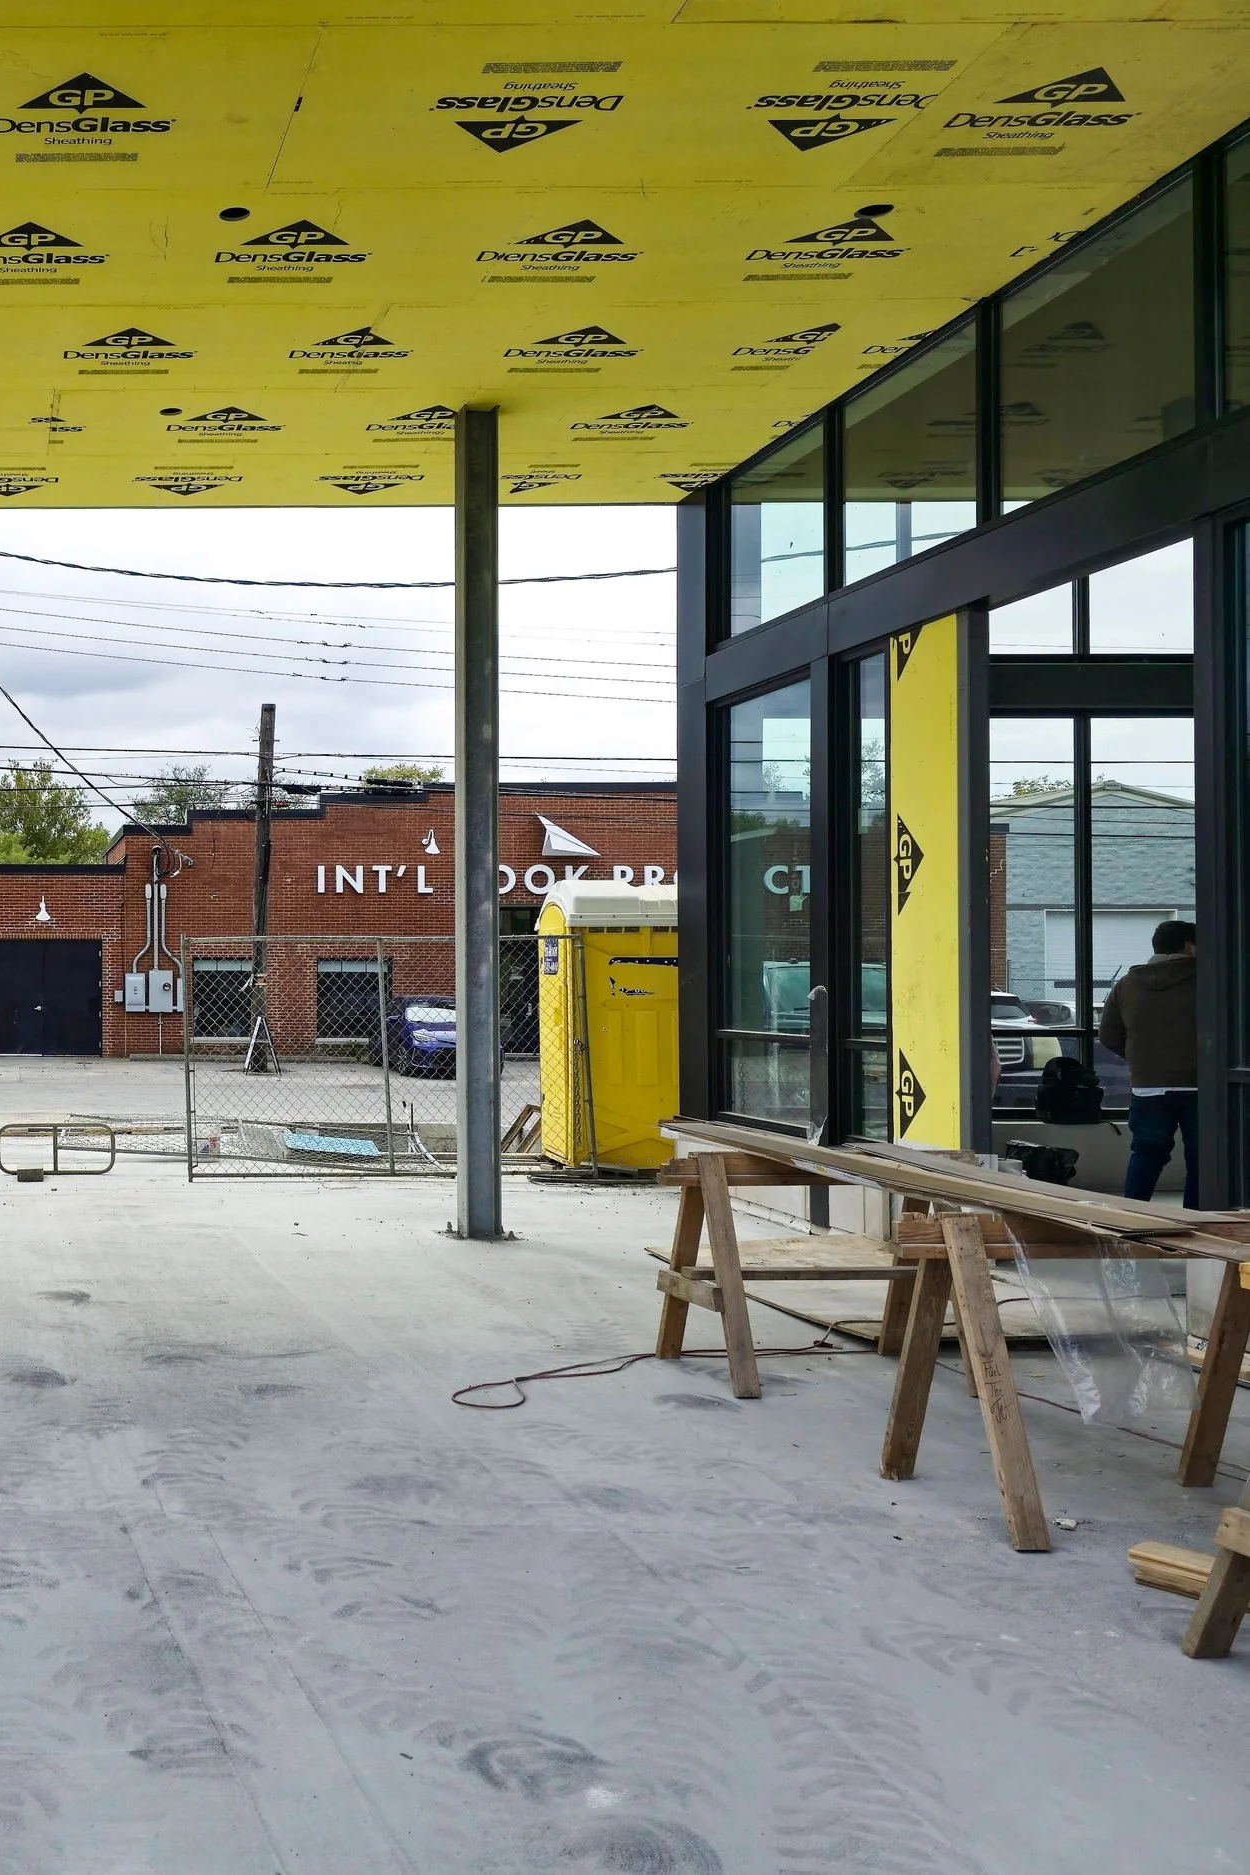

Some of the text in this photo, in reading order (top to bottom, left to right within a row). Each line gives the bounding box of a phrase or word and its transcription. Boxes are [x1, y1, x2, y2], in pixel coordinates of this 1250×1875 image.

[503, 81, 578, 91] Sheathing
[829, 80, 906, 89] Sheathing
[49, 89, 114, 106] GP
[1034, 83, 1108, 101] GP
[433, 95, 624, 112] DensGlass
[943, 111, 1133, 128] DensGlass
[481, 122, 548, 139] GP
[790, 120, 860, 138] GP
[44, 137, 112, 147] Sheathing
[982, 131, 1054, 141] Sheathing
[0, 234, 56, 245] GP
[268, 231, 324, 244] GP
[543, 230, 602, 244] GP
[815, 228, 876, 242] GP
[214, 250, 368, 263] DensGlass
[745, 248, 904, 261] DensGlass
[255, 264, 314, 272] Sheathing
[520, 264, 581, 272] Sheathing
[780, 262, 841, 270] Sheathing
[105, 336, 153, 346] GP
[558, 334, 608, 344] GP
[63, 350, 194, 360] DensGlass
[503, 348, 639, 358] DensGlass
[166, 424, 283, 432] DensGlass
[570, 422, 690, 430] DensGlass
[897, 833, 912, 881] GP
[316, 864, 434, 894] INT'L
[901, 1070, 915, 1119] GP
